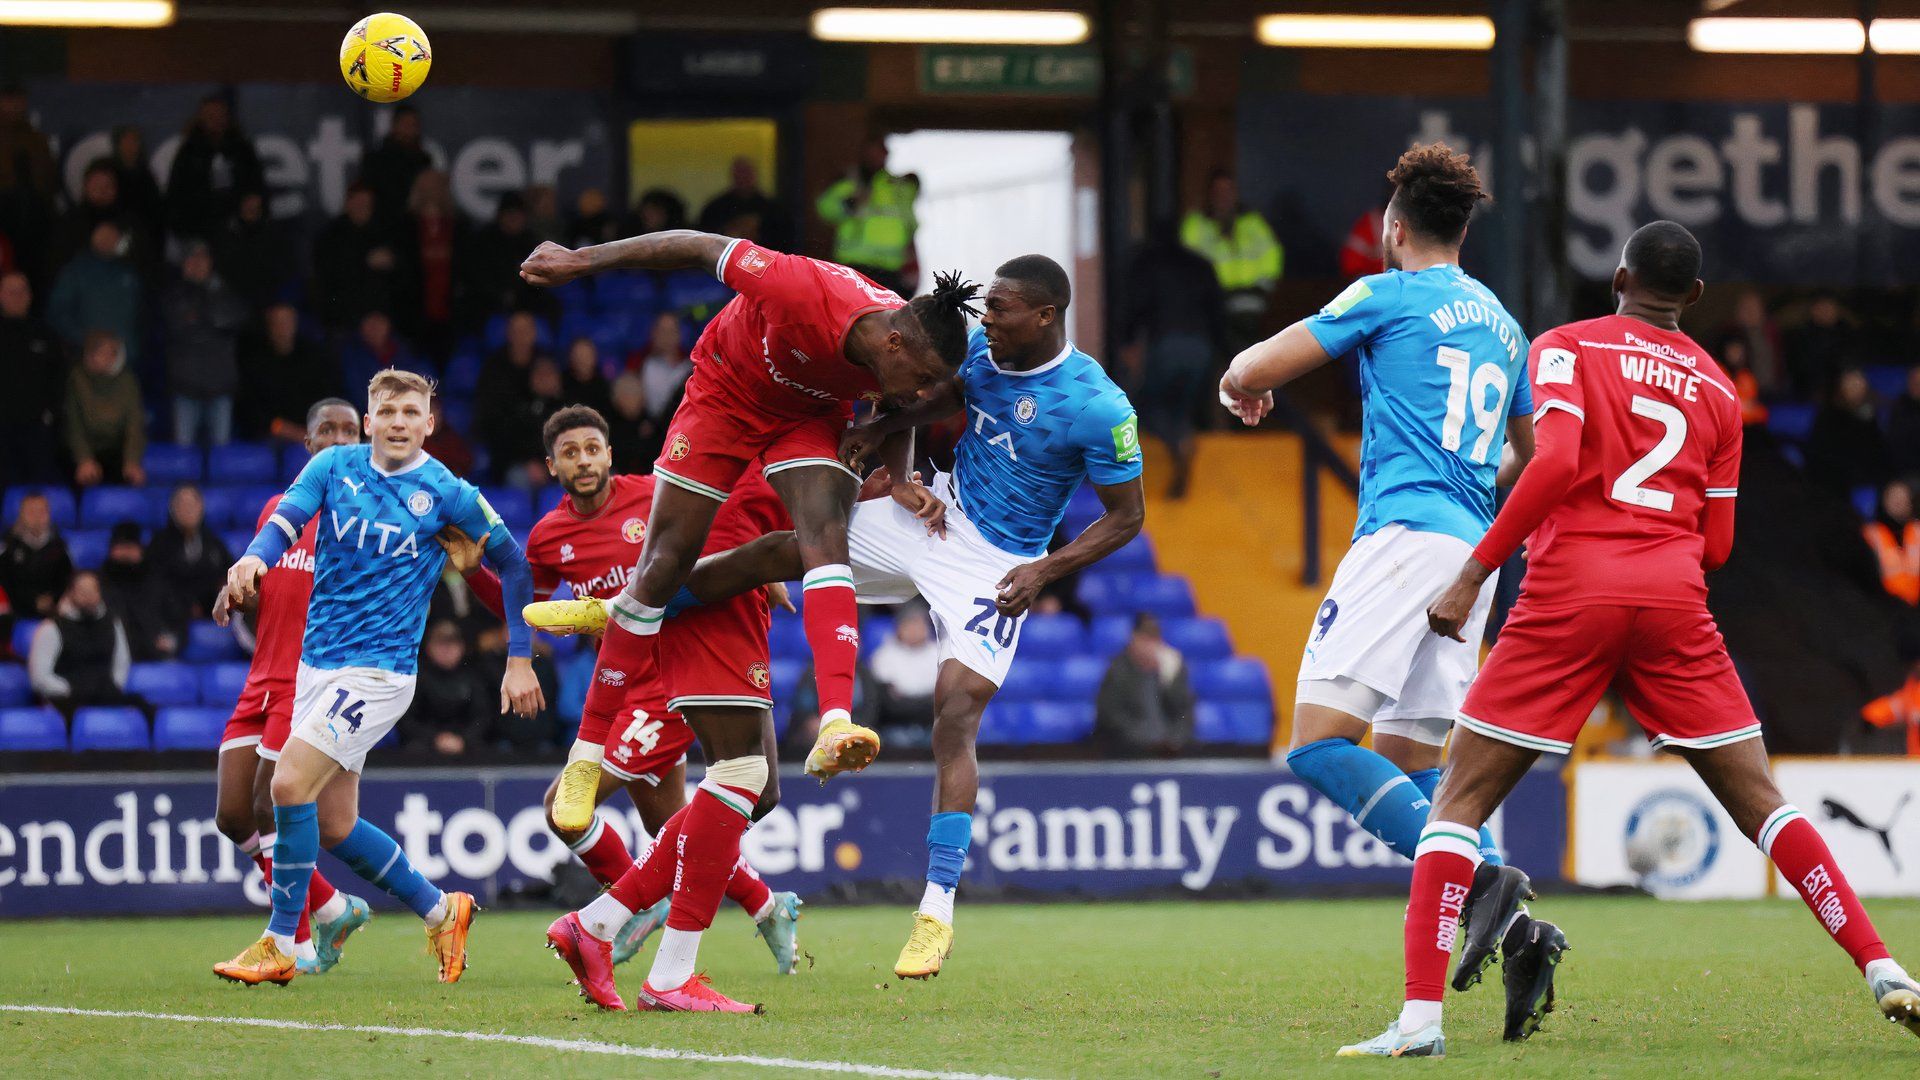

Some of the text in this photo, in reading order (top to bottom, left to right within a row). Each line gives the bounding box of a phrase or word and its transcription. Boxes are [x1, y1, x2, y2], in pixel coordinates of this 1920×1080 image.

[1429, 300, 1519, 362] WOOTTON
[1624, 332, 1697, 368] Poundland
[1620, 354, 1702, 403] WHITE
[1437, 345, 1508, 465] 19
[1610, 394, 1688, 512] 2
[331, 509, 419, 559] VITA
[964, 597, 1017, 648] 20
[1317, 598, 1339, 641] 9
[326, 688, 366, 735] 14
[620, 708, 665, 756] 14
